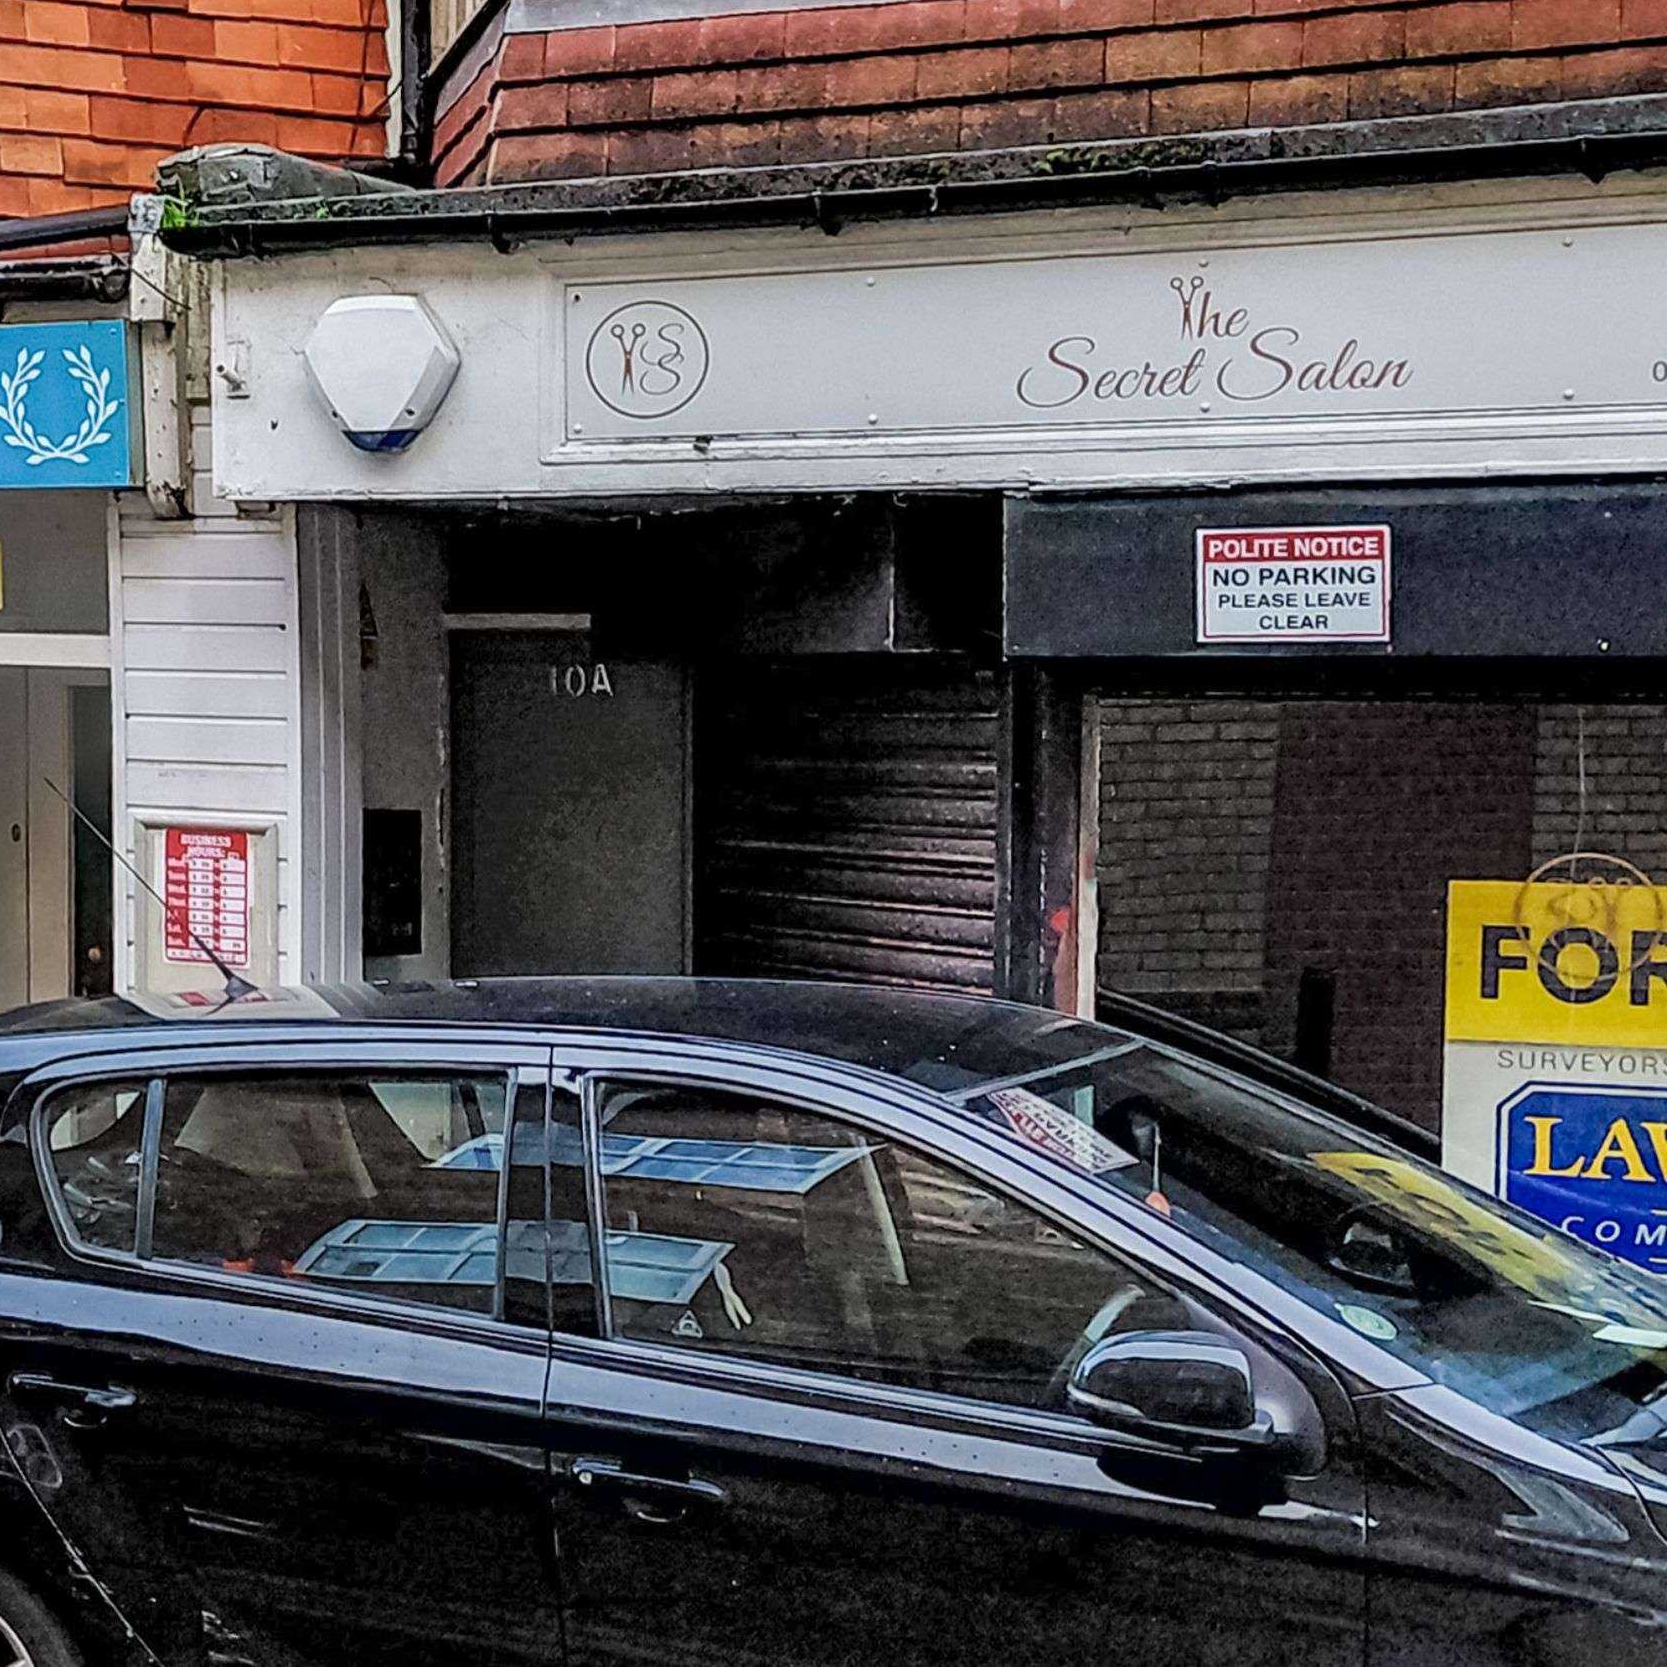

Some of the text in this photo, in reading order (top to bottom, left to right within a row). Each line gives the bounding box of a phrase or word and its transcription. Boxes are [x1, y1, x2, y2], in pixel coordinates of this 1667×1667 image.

[1017, 327, 1414, 408] Secret Salon
[1208, 536, 1380, 559] POLITE NOTICE
[1212, 566, 1376, 587] NO PARKING
[1218, 591, 1372, 609] PLEASE LEAVE
[1258, 614, 1329, 631] CLEAR
[550, 663, 614, 697] 10A
[1497, 1050, 1667, 1075] SURVEYOR
